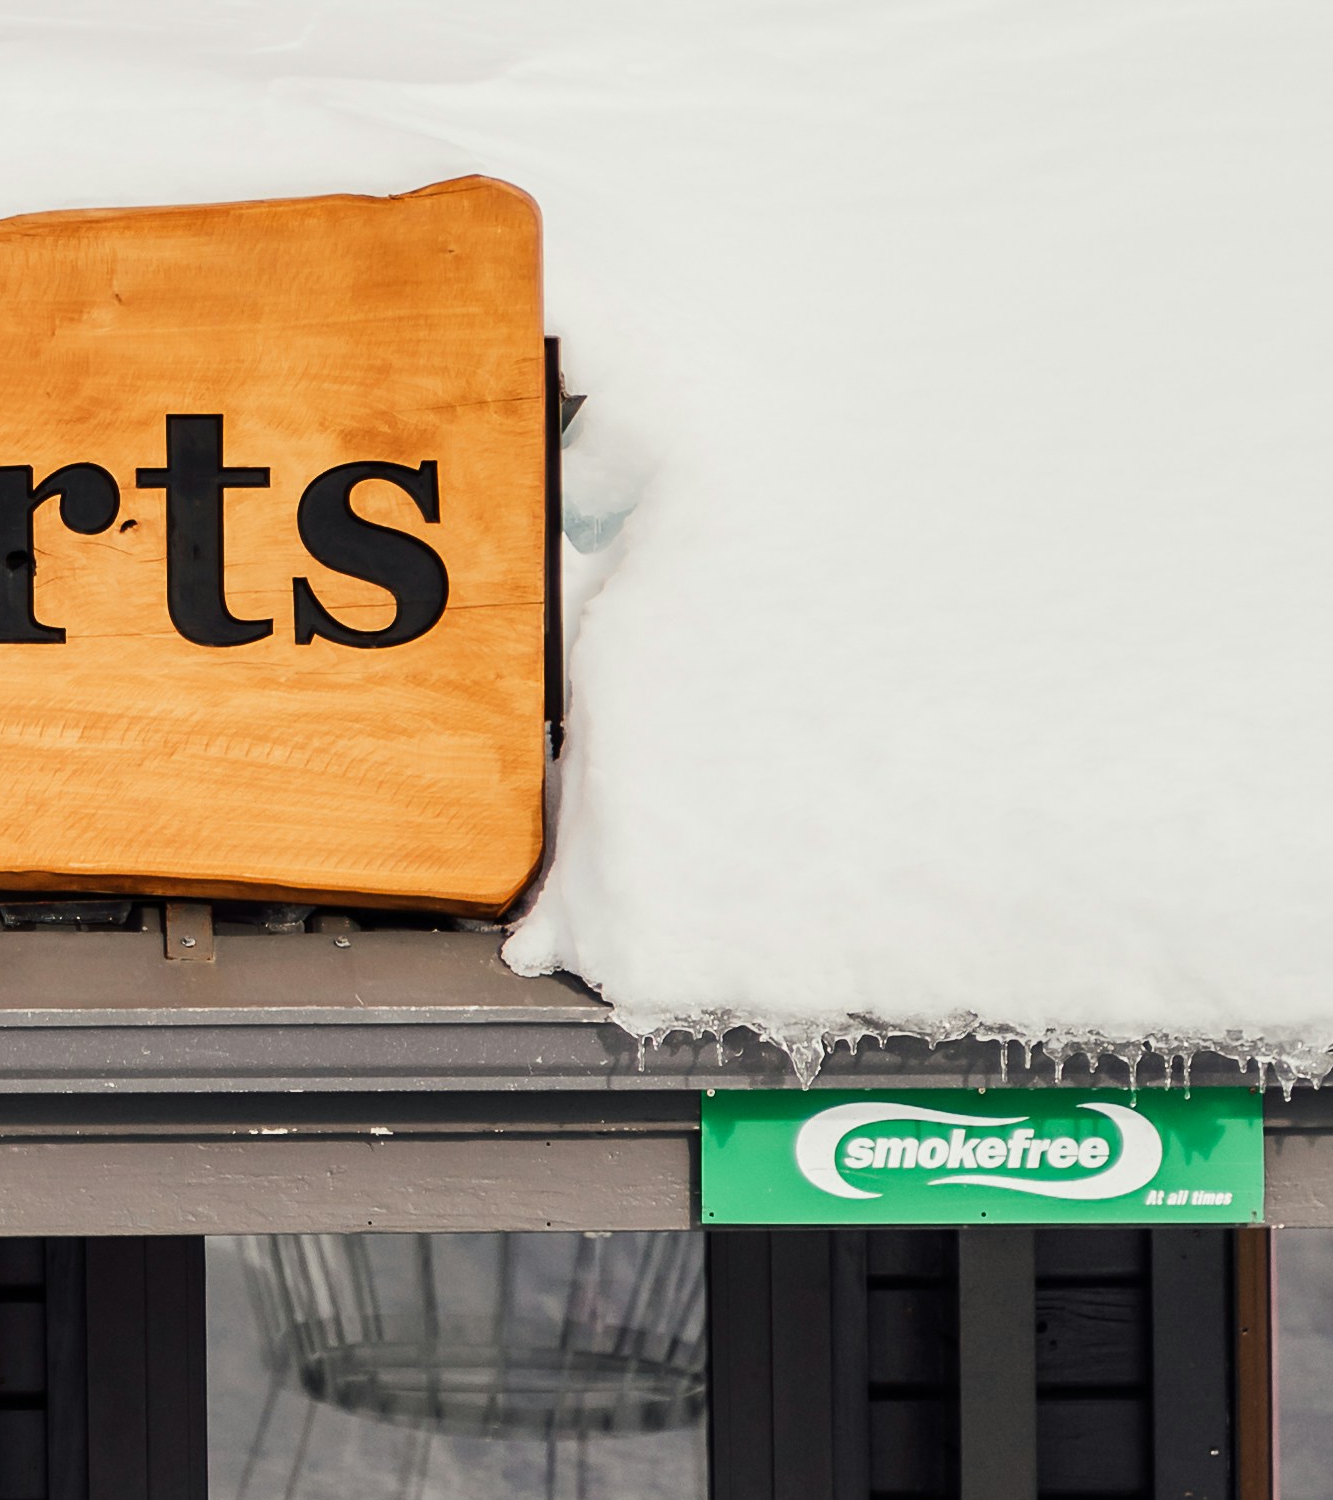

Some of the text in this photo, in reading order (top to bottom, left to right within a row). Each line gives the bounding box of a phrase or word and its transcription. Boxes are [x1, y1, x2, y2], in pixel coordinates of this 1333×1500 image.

[843, 1128, 1110, 1170] smokefree
[1145, 1189, 1233, 1206] At all times
